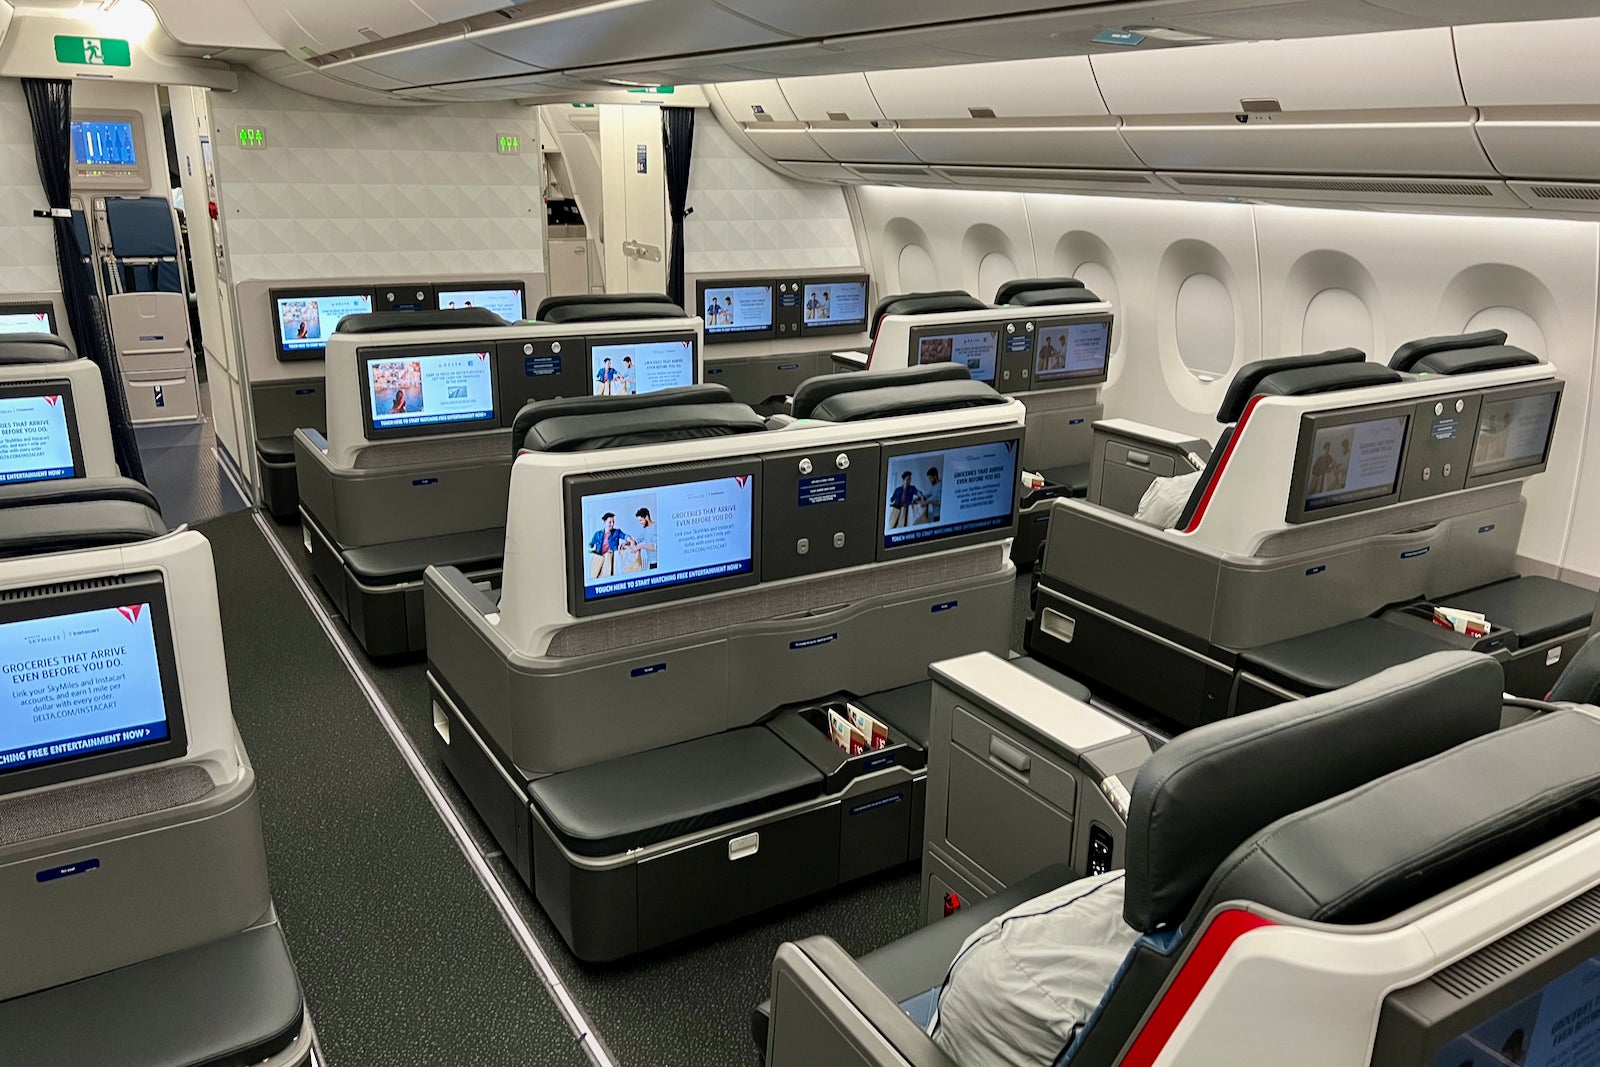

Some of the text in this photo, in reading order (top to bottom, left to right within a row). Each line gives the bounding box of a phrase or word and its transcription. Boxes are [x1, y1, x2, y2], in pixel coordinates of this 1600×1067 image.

[672, 509, 702, 519] GROCERIES
[703, 506, 716, 515] THAT
[692, 516, 711, 525] BEFORE
[595, 586, 613, 594] TOUCH
[614, 583, 626, 592] HERE
[635, 578, 650, 587] START
[651, 574, 676, 585] WATCHING
[689, 566, 726, 578] ENTERTAINMENT
[2, 646, 127, 674] GROCERIES THAT ARRIVE
[13, 658, 123, 684] EVEN BEFORE YOU DO.
[13, 674, 126, 698] Link your SkyMiles and Instacart
[21, 695, 54, 706] accounts,
[56, 691, 70, 699] and
[93, 684, 108, 693] mile
[110, 684, 121, 693] per
[32, 701, 117, 722] DELTA.COM/INSTACART
[33, 694, 114, 712] dollar with every order.
[28, 748, 49, 759] FREE
[50, 733, 121, 755] ENTERTAINMENT
[123, 729, 144, 740] NOW
